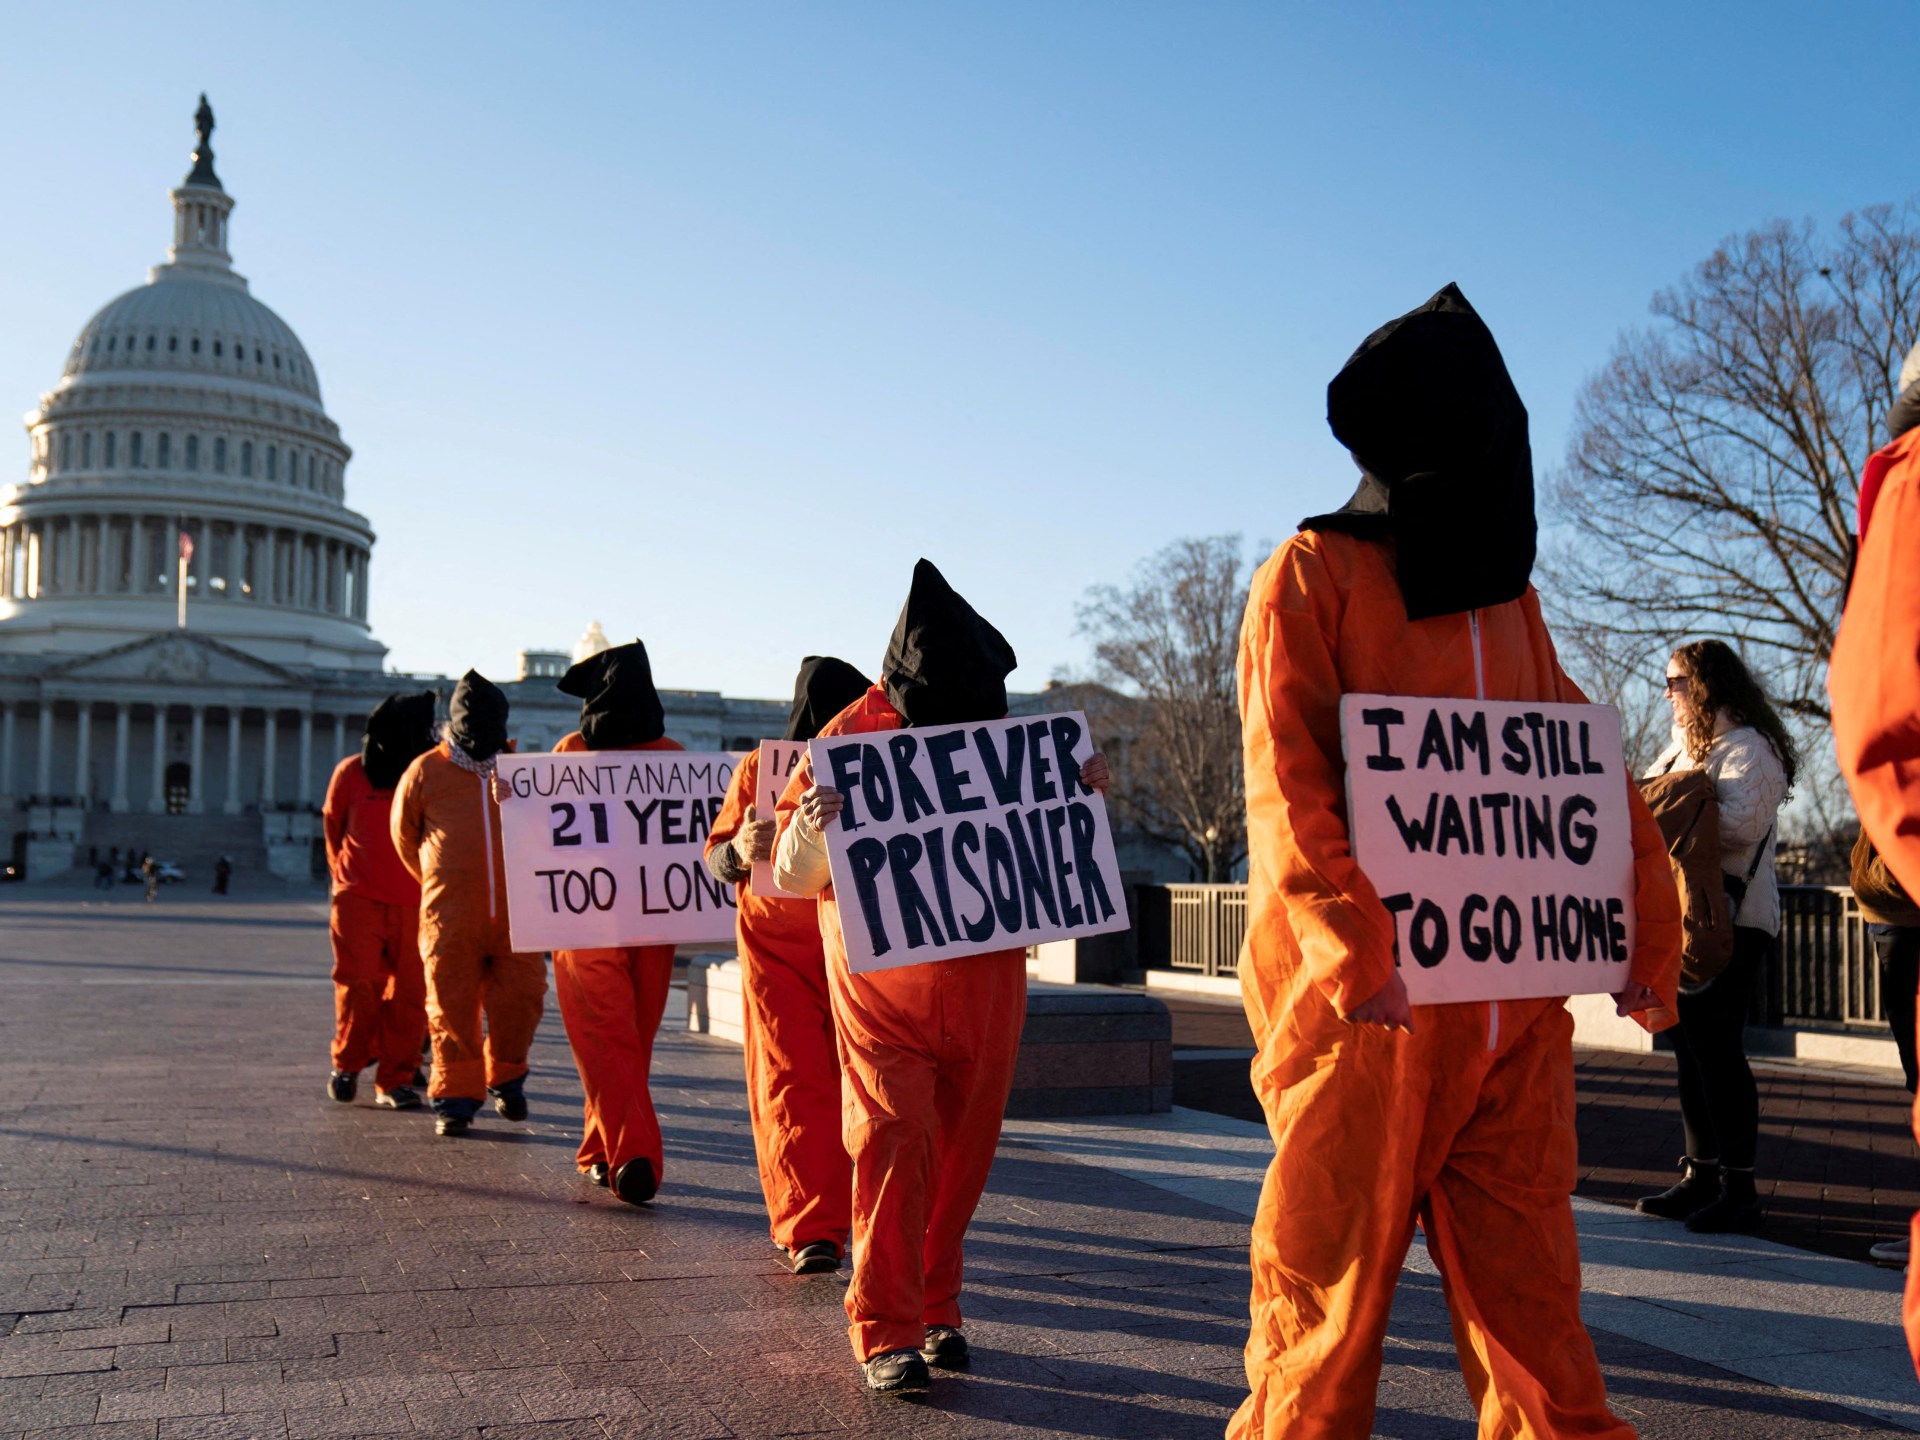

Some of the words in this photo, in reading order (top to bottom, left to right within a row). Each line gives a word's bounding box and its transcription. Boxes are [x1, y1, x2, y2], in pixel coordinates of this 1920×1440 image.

[827, 717, 1095, 831] FOREVER
[1362, 708, 1405, 771] I
[1417, 709, 1490, 775] AM
[1501, 712, 1605, 779] STILL
[511, 762, 733, 798] GUANTANAMO
[550, 802, 609, 846] 21
[1385, 792, 1598, 865] WAITING
[534, 867, 617, 914] TOO
[846, 802, 1116, 957] PRISONER
[1381, 892, 1449, 968] TO
[1460, 894, 1522, 964] GO
[1532, 894, 1628, 965] HOME
